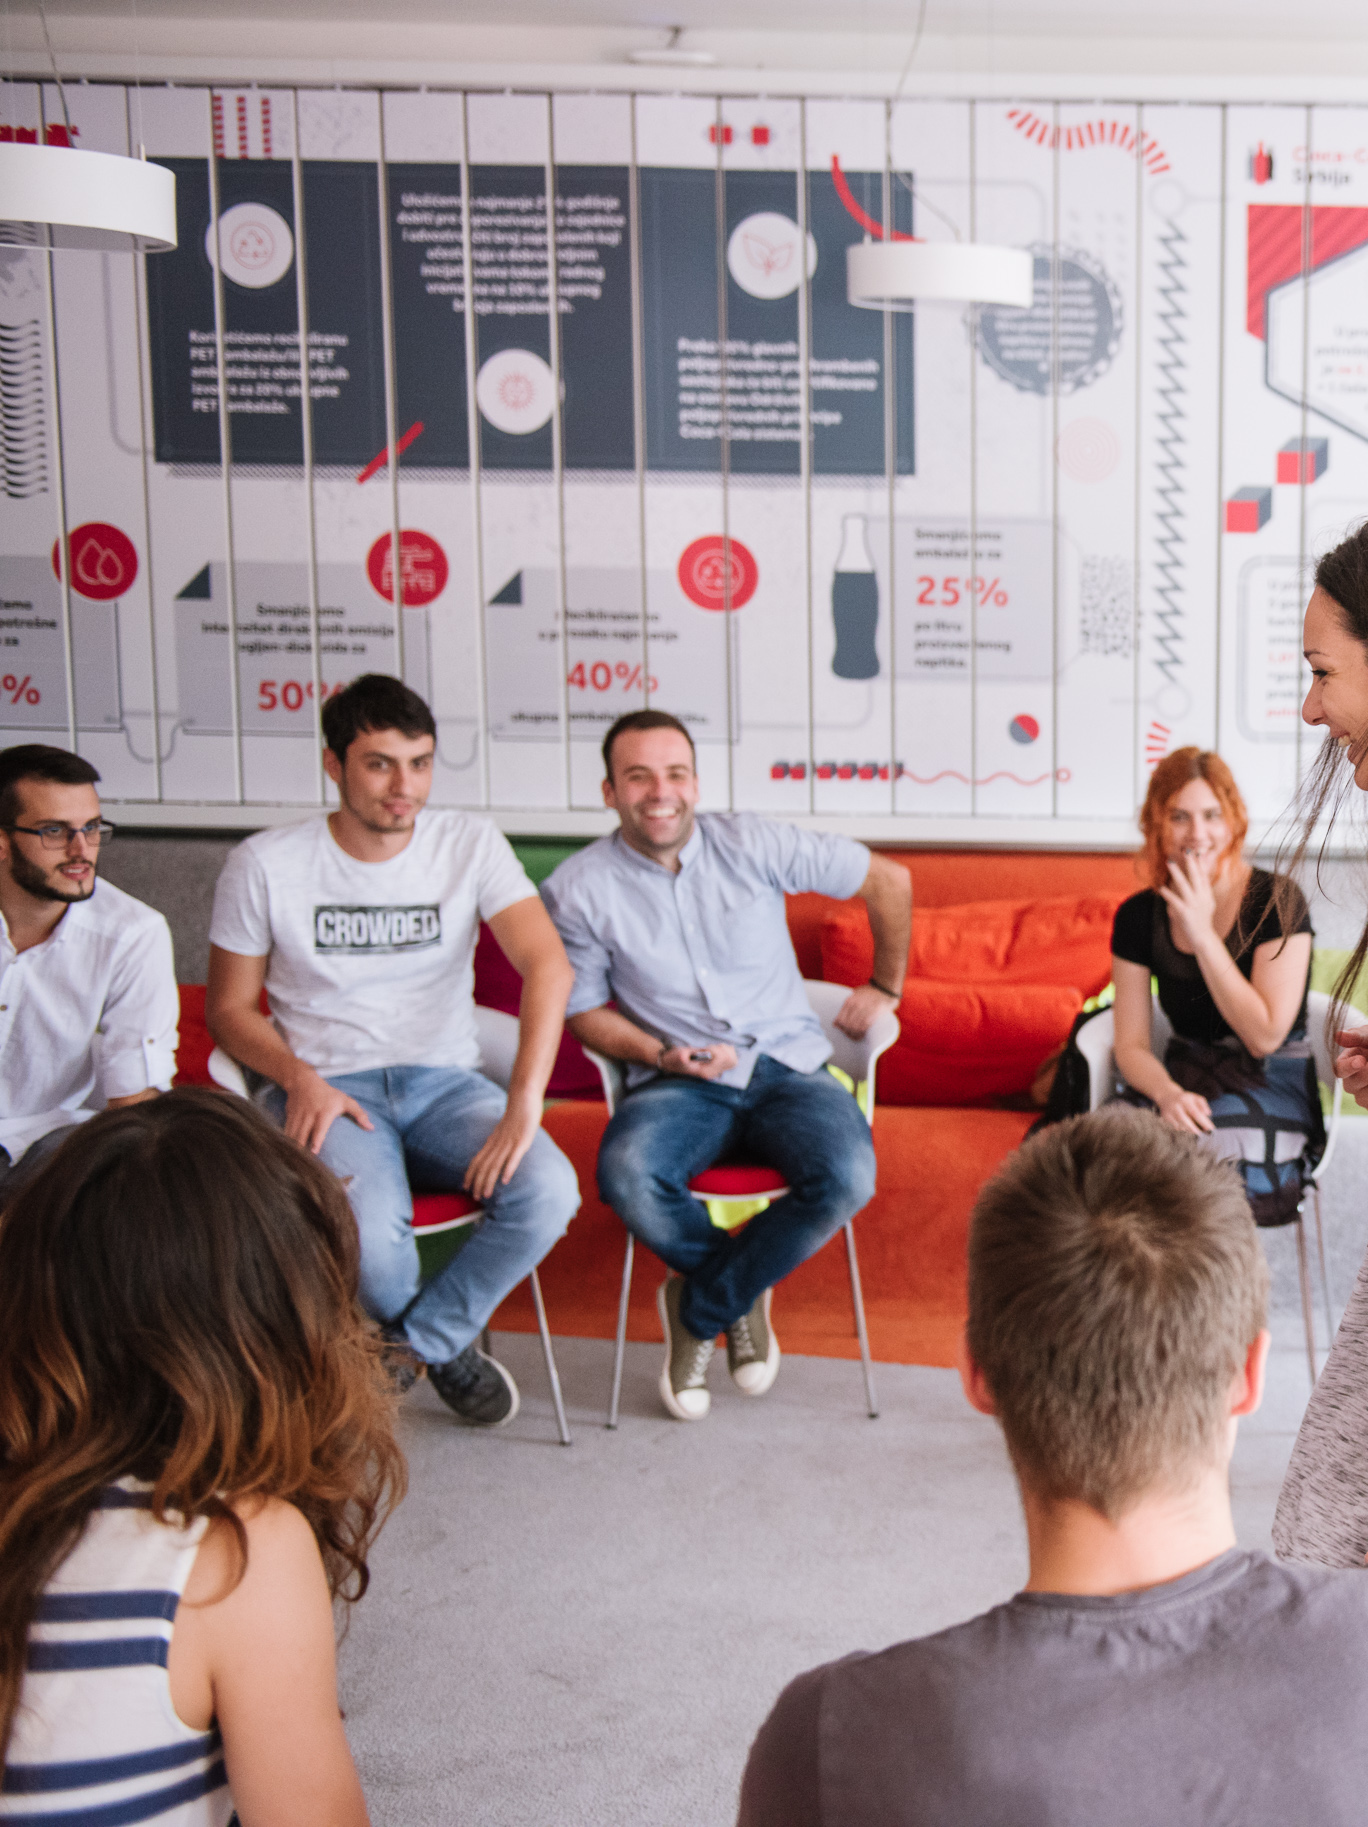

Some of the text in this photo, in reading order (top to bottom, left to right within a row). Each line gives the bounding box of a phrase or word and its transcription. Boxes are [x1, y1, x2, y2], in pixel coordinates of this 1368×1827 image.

[914, 527, 1001, 542] Smanjićmo
[916, 575, 1009, 608] 25%
[256, 602, 344, 617] Smanjićmo
[566, 661, 659, 694] 40%
[317, 908, 440, 946] CROWDED
